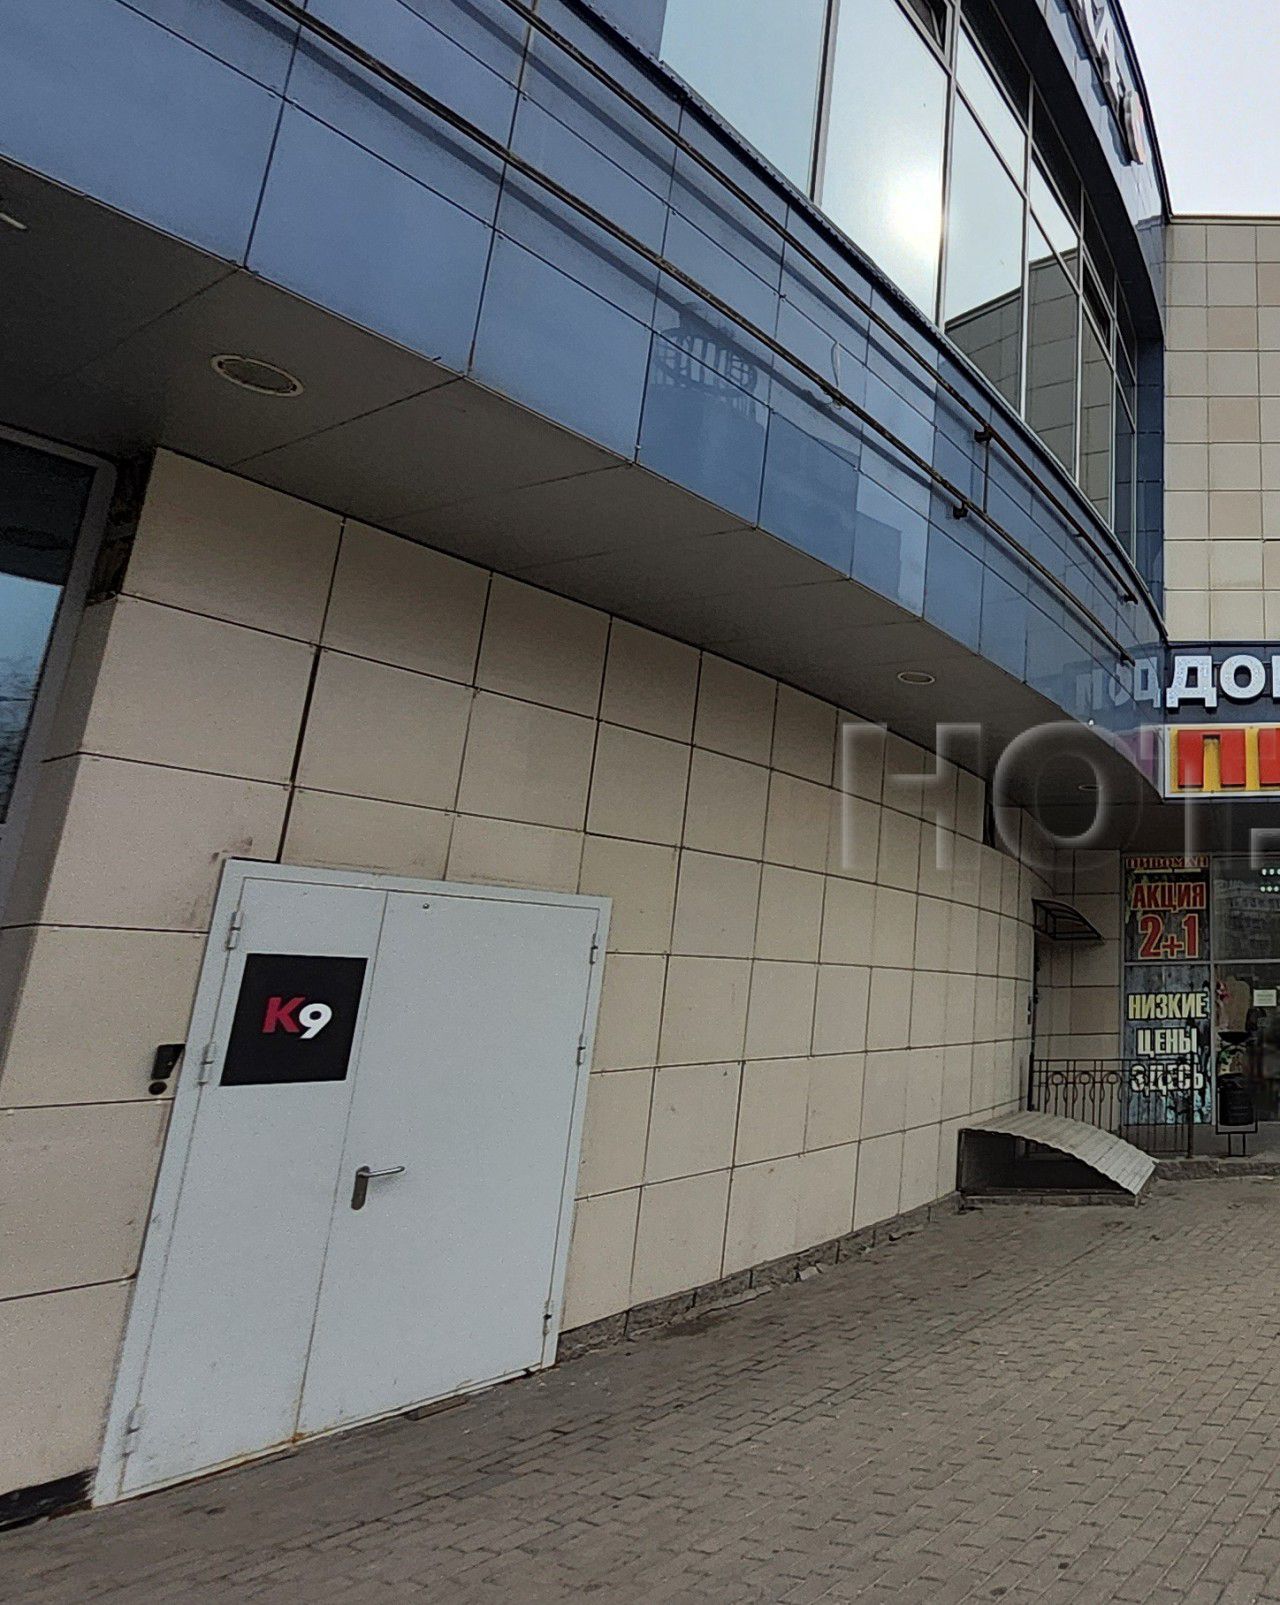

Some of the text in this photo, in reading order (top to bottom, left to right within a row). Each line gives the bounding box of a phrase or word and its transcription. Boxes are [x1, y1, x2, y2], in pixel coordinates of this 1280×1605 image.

[1131, 882, 1206, 913] АКЦИЯ
[1138, 914, 1198, 959] 2+1
[262, 997, 333, 1039] K9
[1128, 992, 1207, 1019] НИЗКИЕ
[1137, 1028, 1198, 1058] ЦЕНЫ
[1131, 1063, 1204, 1096] ЗДЕСЬ
